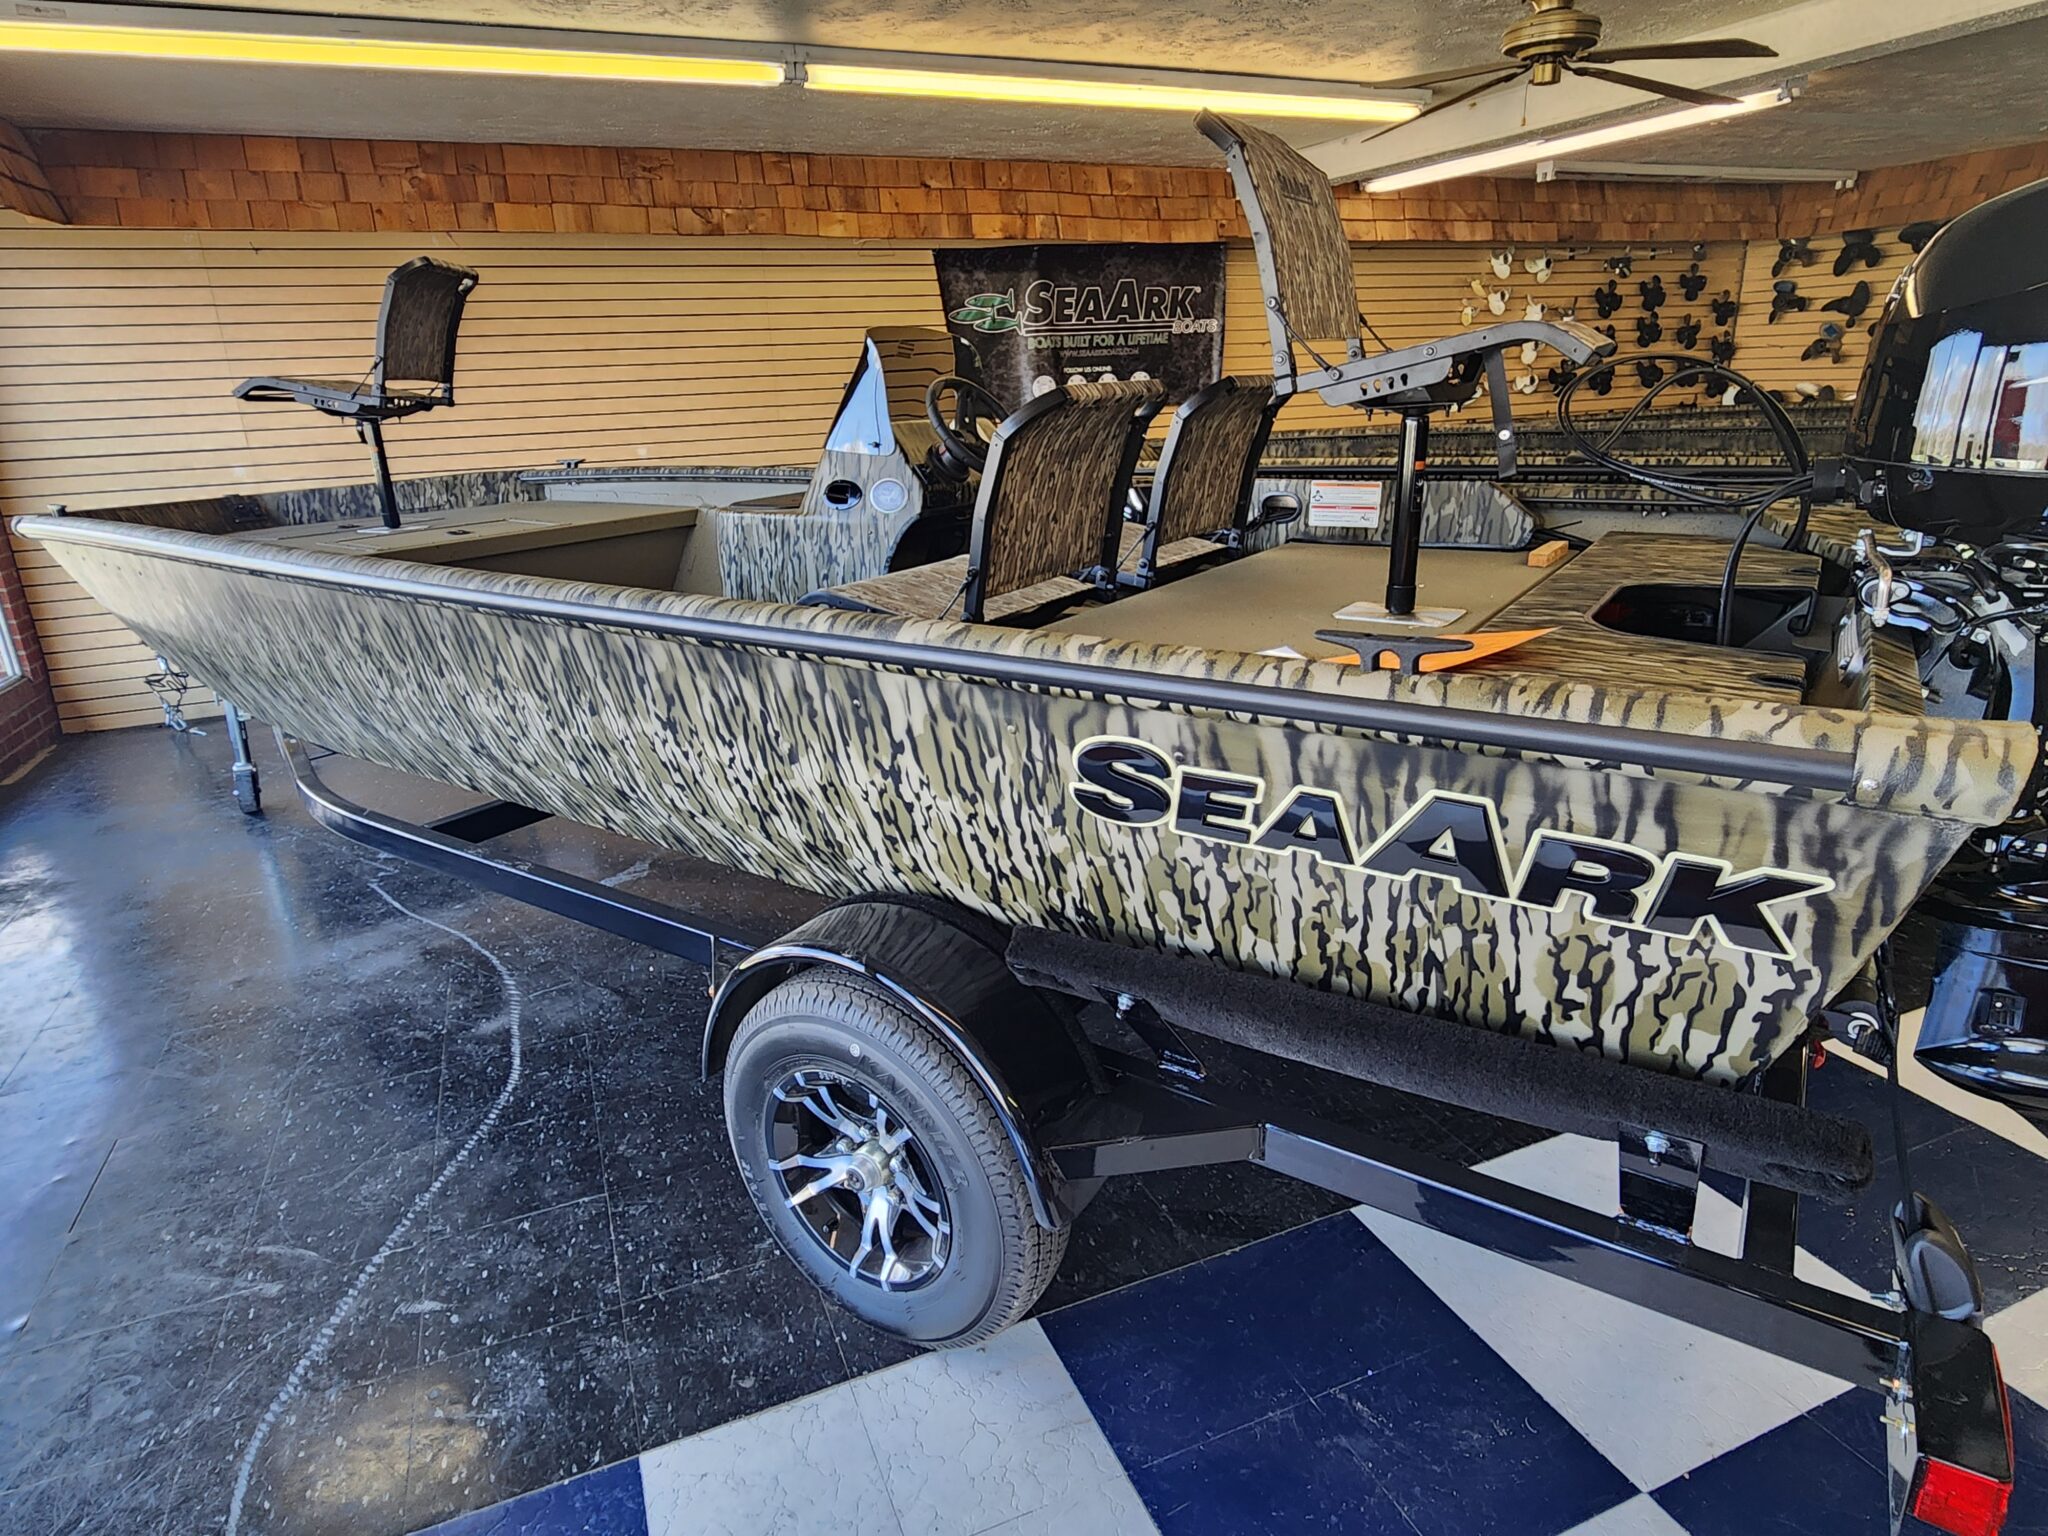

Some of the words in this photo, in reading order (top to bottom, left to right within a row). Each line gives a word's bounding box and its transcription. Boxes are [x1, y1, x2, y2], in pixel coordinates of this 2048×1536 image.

[1172, 318, 1218, 334] BOATS
[1027, 337, 1062, 350] BOATS
[1063, 336, 1091, 348] BUILT
[1093, 335, 1115, 347] FOR
[1117, 334, 1126, 346] A
[1127, 332, 1169, 345] LIFETIME
[1063, 366, 1084, 374] FOLLOW
[1092, 365, 1113, 373] ONLINE
[1069, 735, 1835, 959] SEAARK
